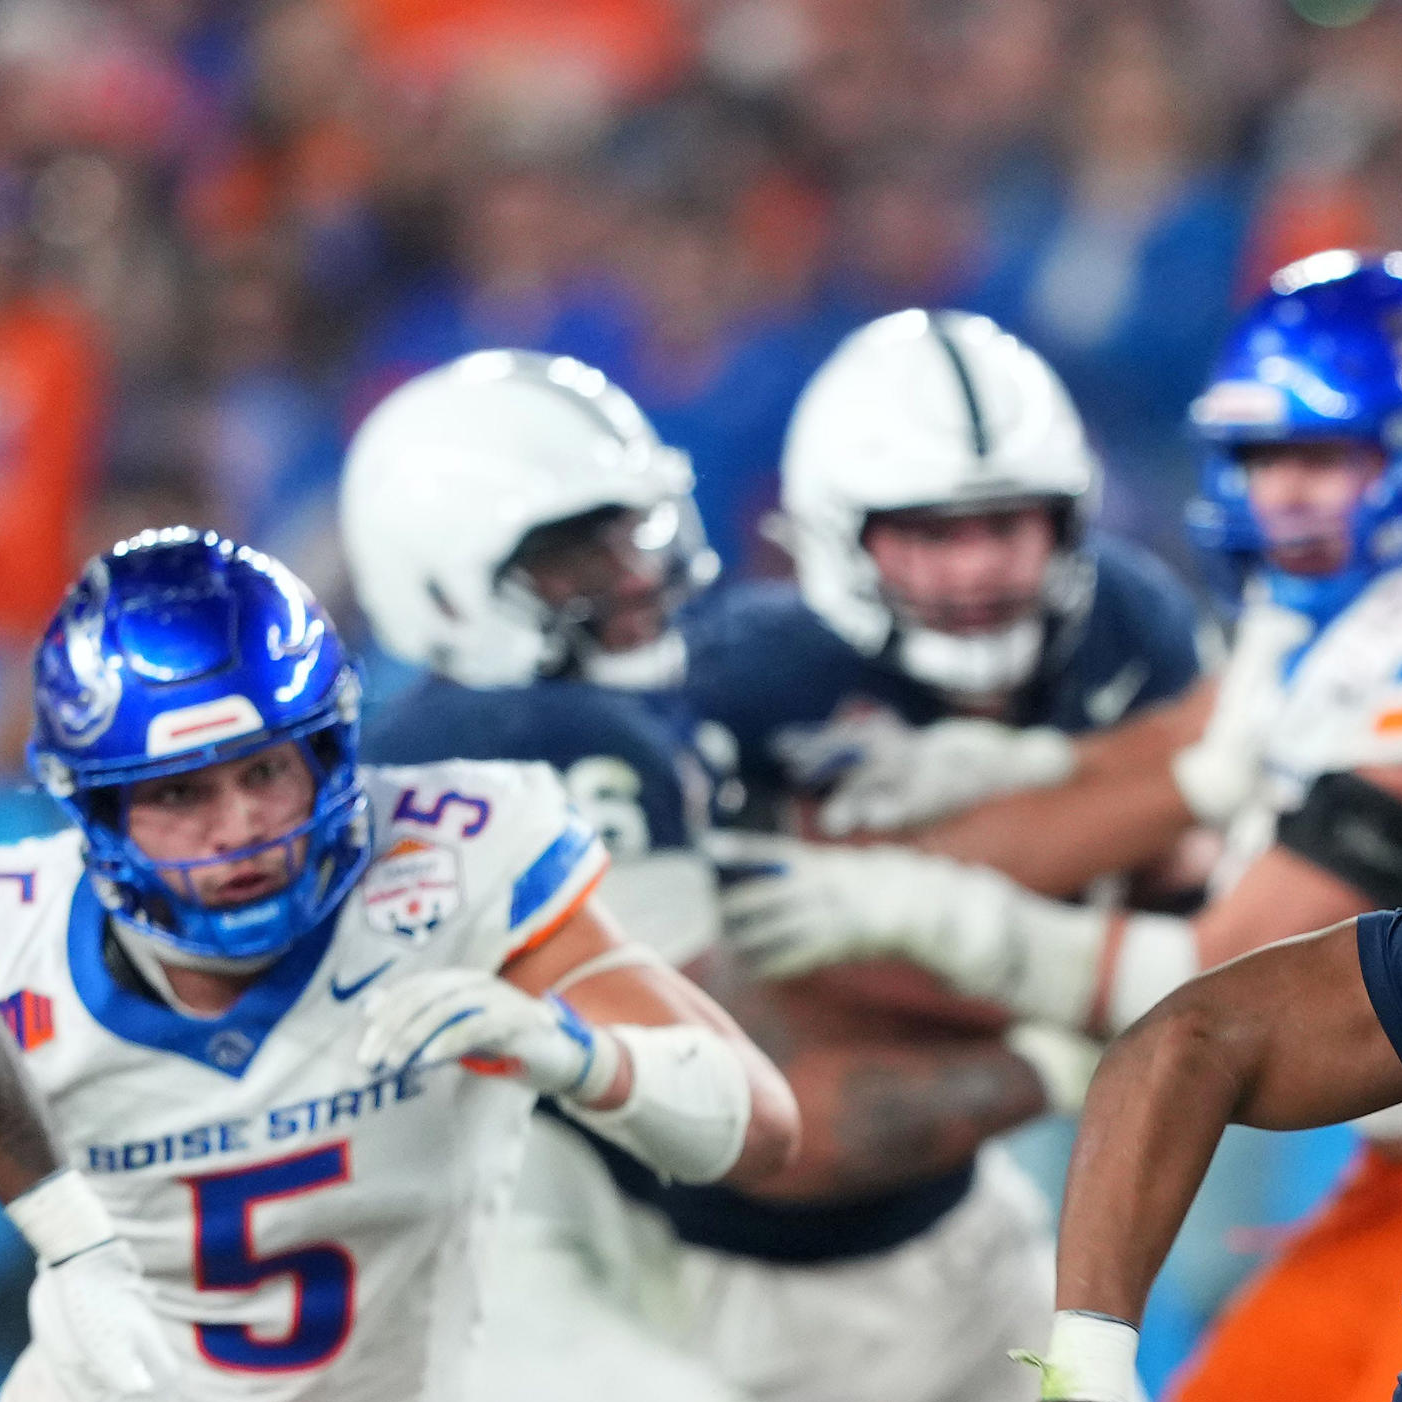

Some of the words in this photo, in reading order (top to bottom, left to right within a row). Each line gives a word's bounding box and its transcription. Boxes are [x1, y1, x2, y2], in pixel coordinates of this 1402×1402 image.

[393, 787, 490, 838] 5
[88, 1119, 248, 1173] BOISE
[176, 1137, 357, 1376] 5
